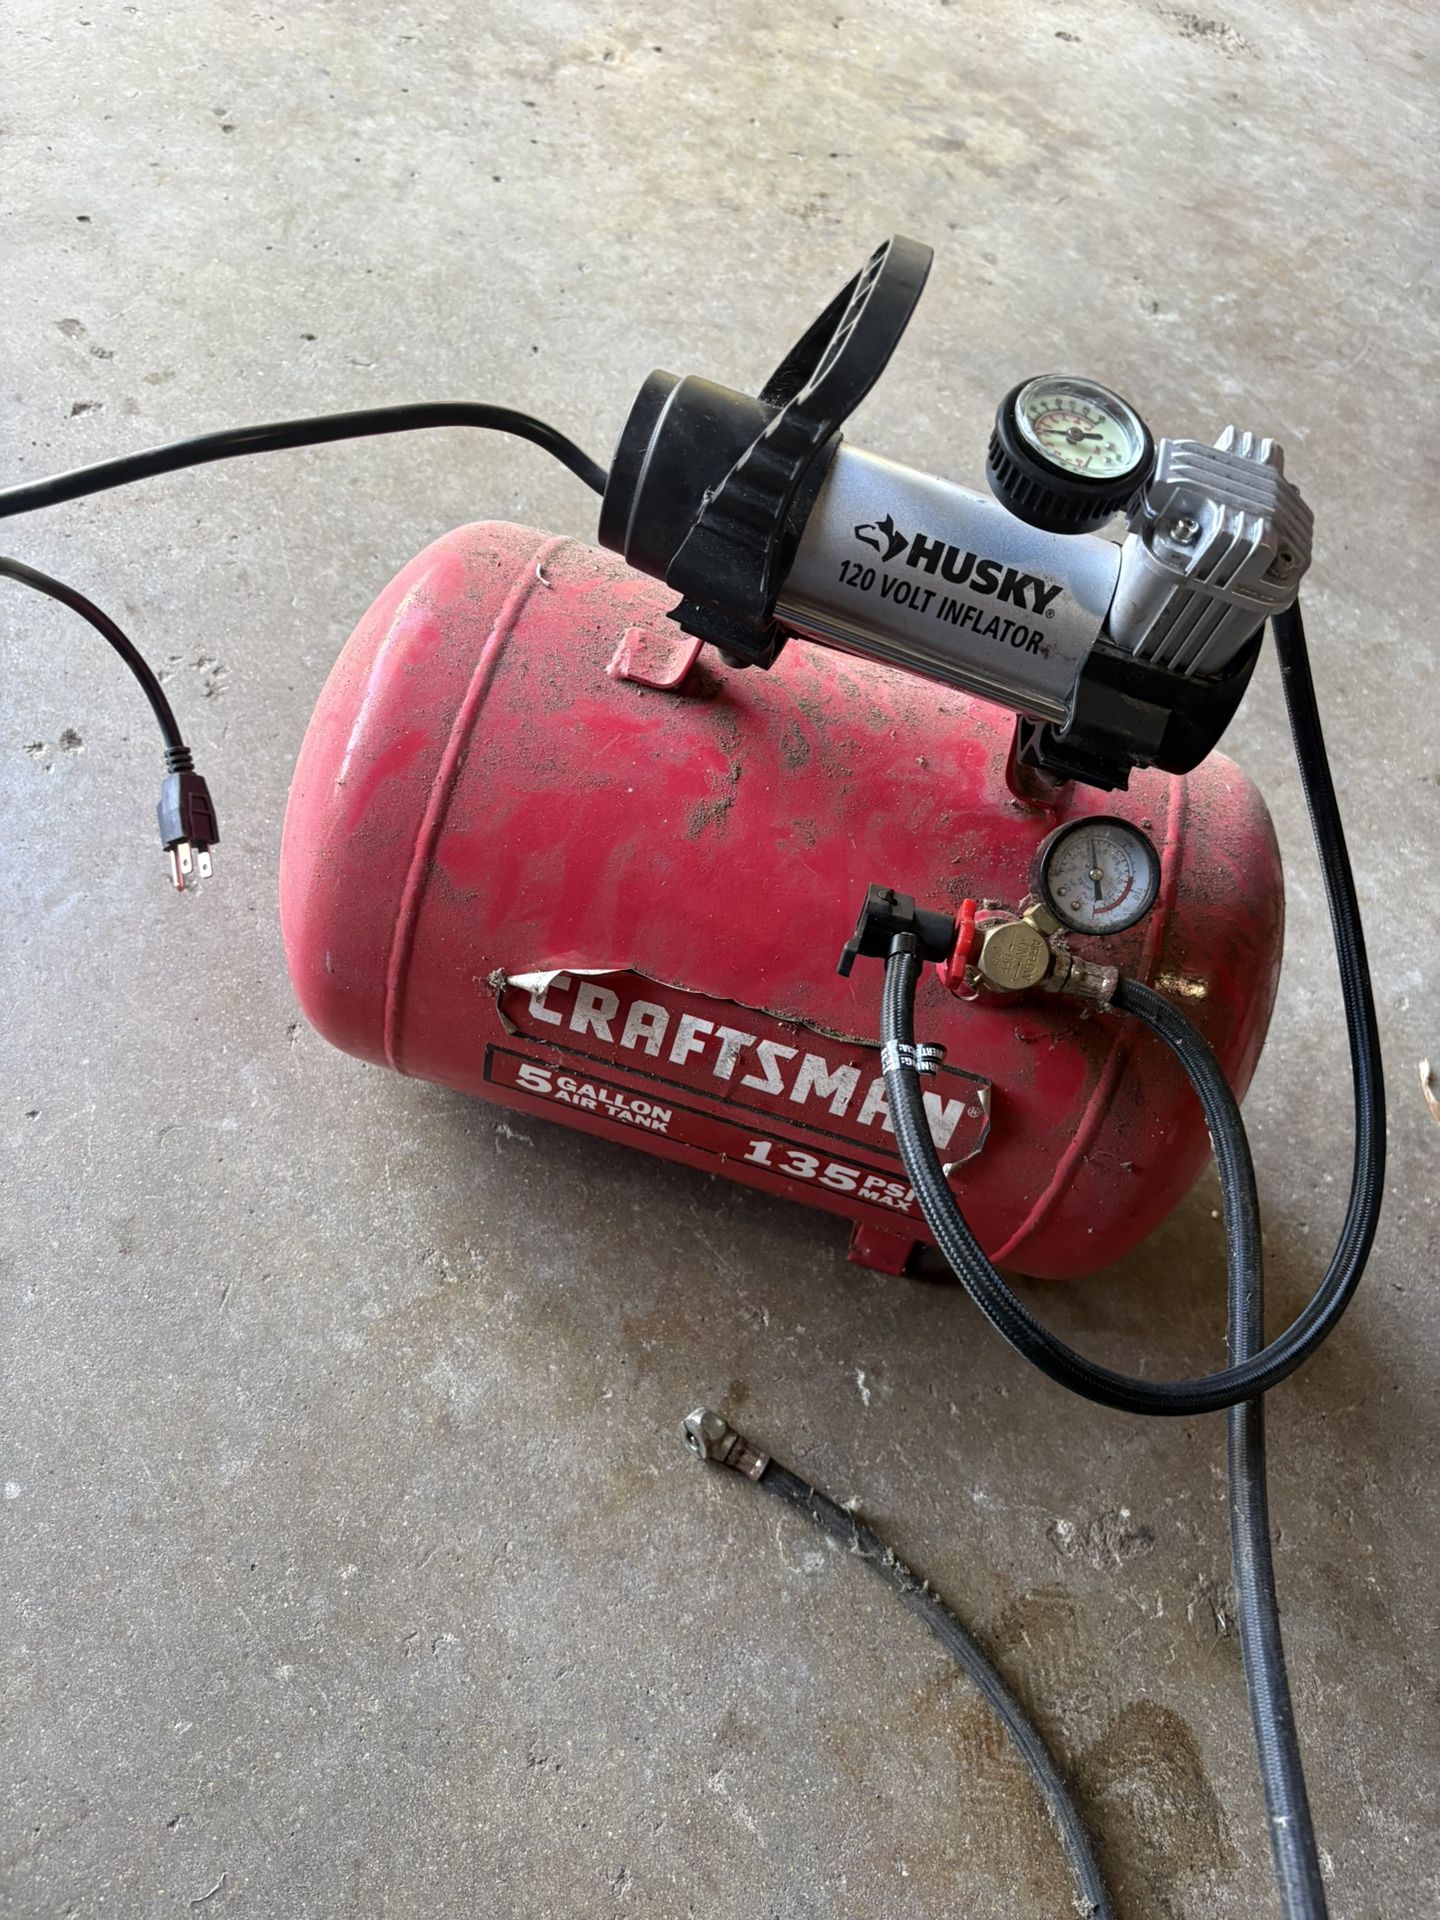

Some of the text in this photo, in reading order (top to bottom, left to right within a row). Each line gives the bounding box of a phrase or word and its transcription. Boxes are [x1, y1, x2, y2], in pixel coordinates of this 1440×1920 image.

[838, 560, 1045, 655] 120 VOLT INFLATOR
[515, 1063, 673, 1122] 5 GALLON
[554, 1090, 668, 1133] AIR TANK
[743, 1140, 917, 1201] 135 PSI
[857, 1188, 912, 1212] MAX
